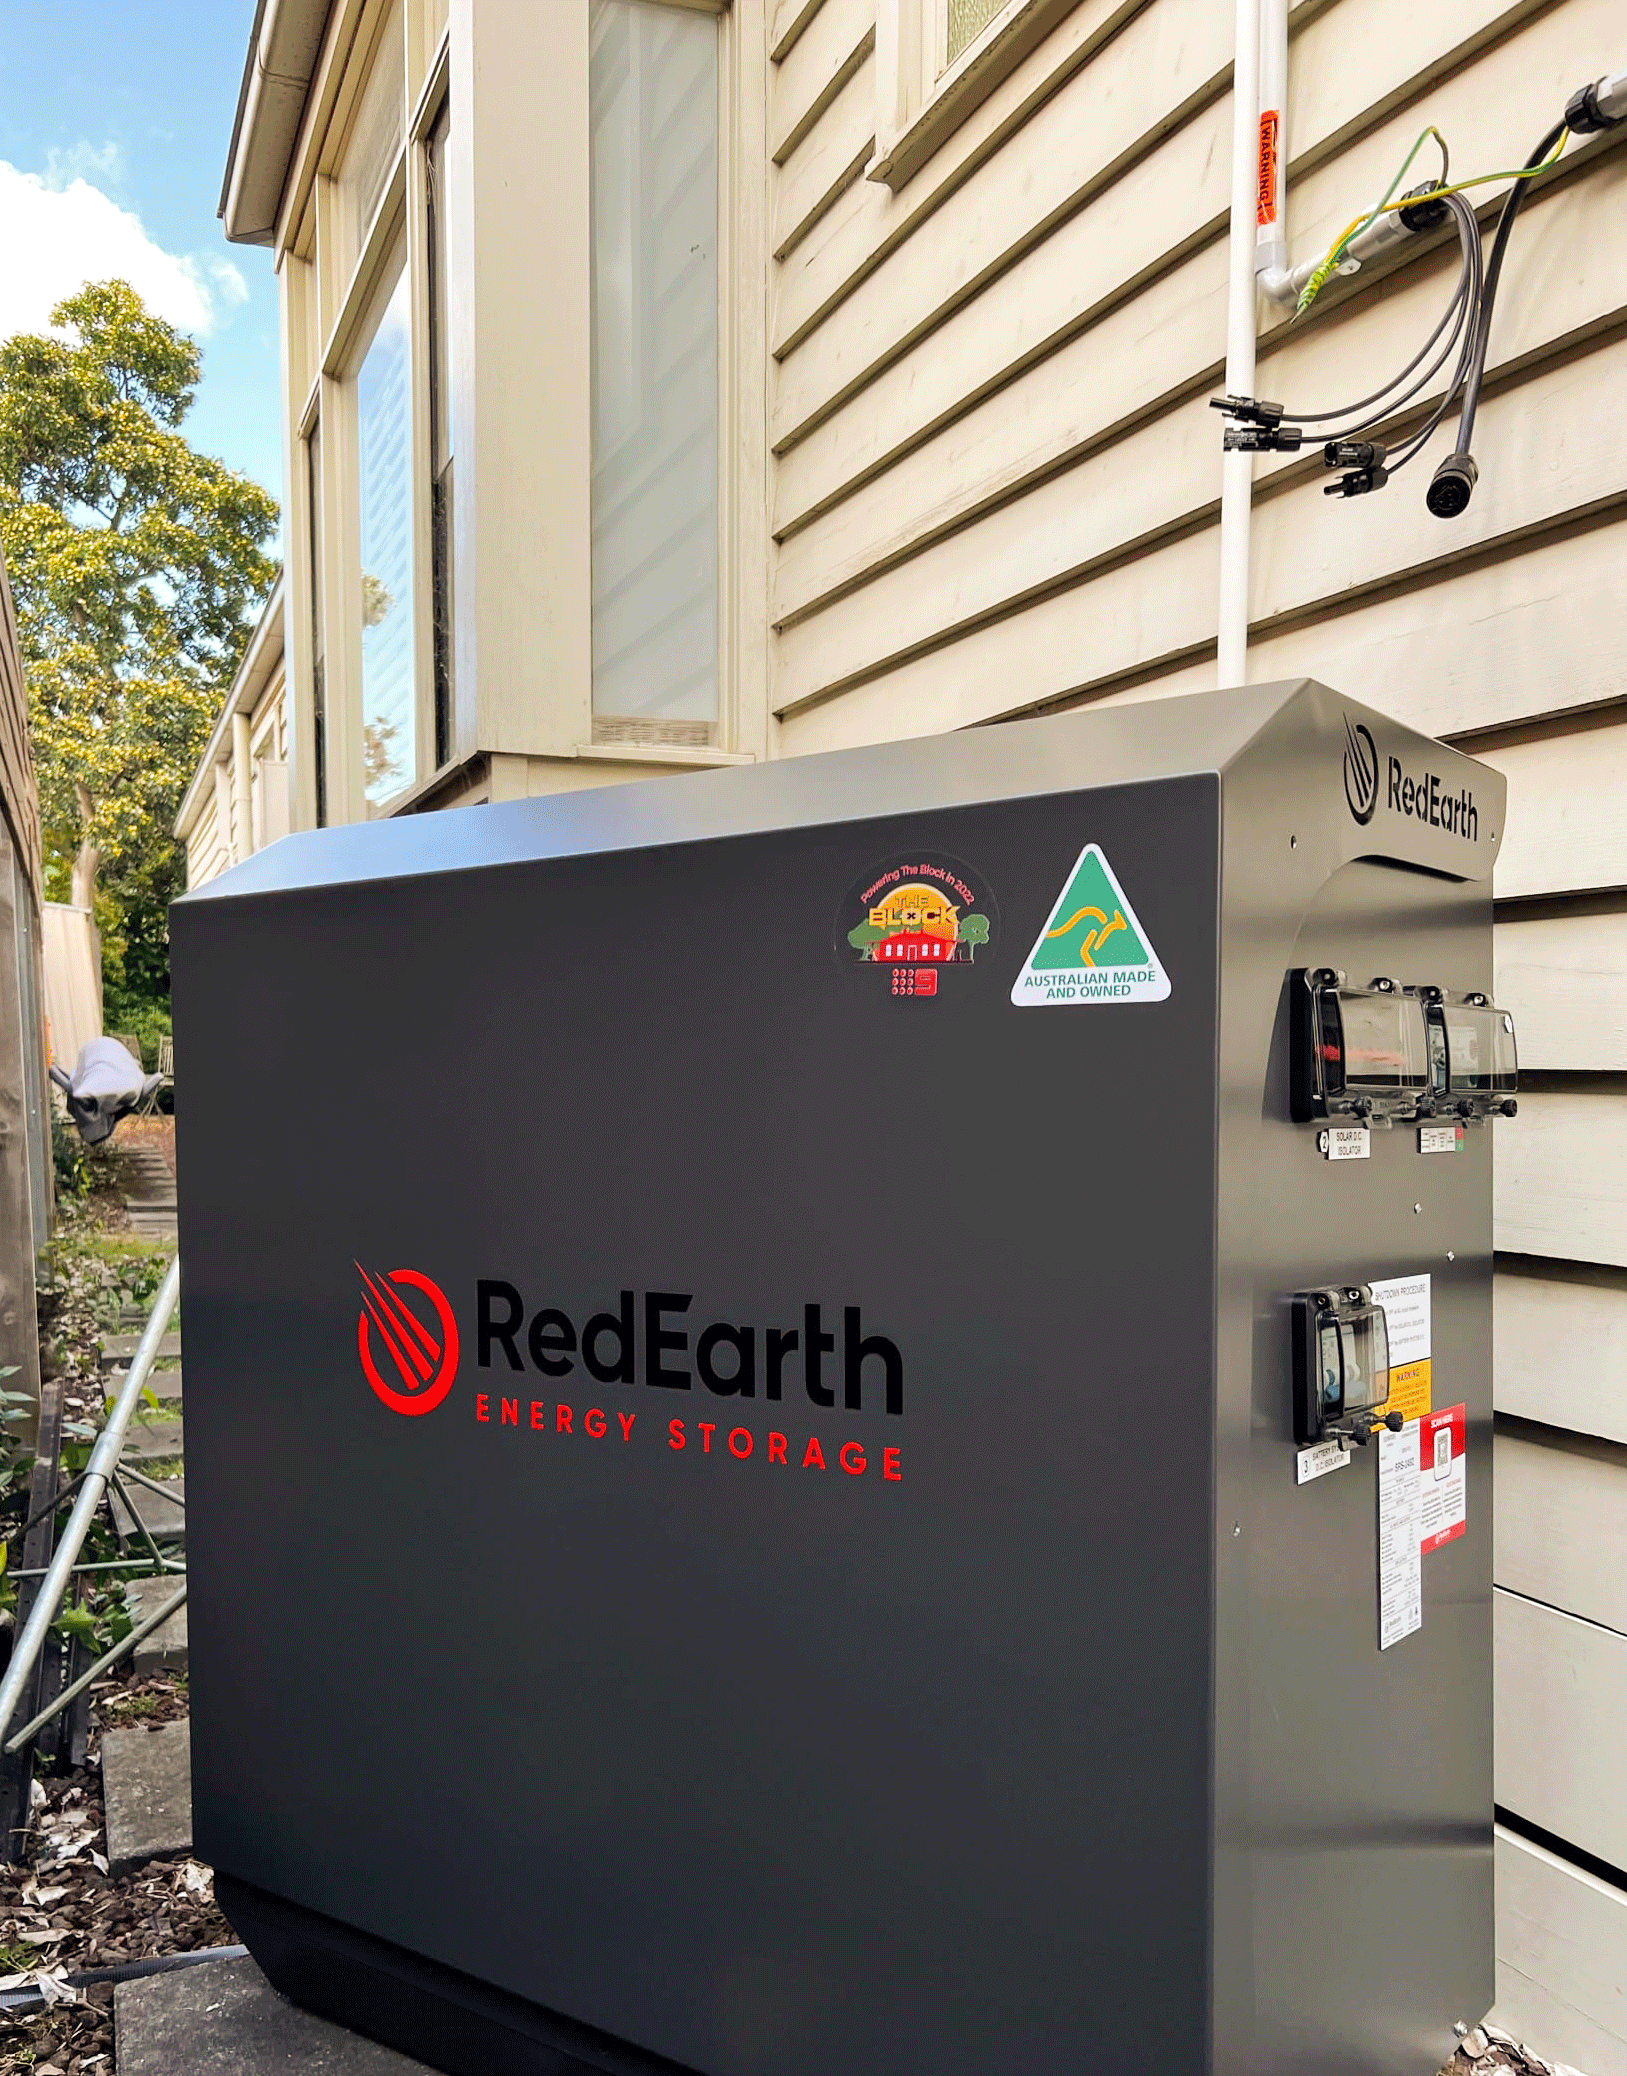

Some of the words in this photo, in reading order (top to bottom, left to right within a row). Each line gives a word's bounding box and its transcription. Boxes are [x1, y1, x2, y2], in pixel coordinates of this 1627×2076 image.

[1259, 126, 1271, 201] WARNING
[1388, 756, 1478, 842] RedEarth
[860, 869, 901, 904] Powering
[900, 864, 919, 877] The
[919, 863, 946, 881] Block
[953, 879, 975, 906] 2022
[868, 905, 961, 930] BLOCK
[1024, 972, 1108, 987] AUSTRALIAN
[1113, 970, 1156, 983] MADE
[1046, 987, 1076, 999] AND
[1080, 984, 1131, 997] OWNED
[1336, 1131, 1353, 1142] SOLAR
[1338, 1145, 1362, 1155] ISOLATOR
[475, 1278, 903, 1415] RedEarth
[475, 1393, 636, 1442] ENERGY
[668, 1418, 902, 1481] STORAGE
